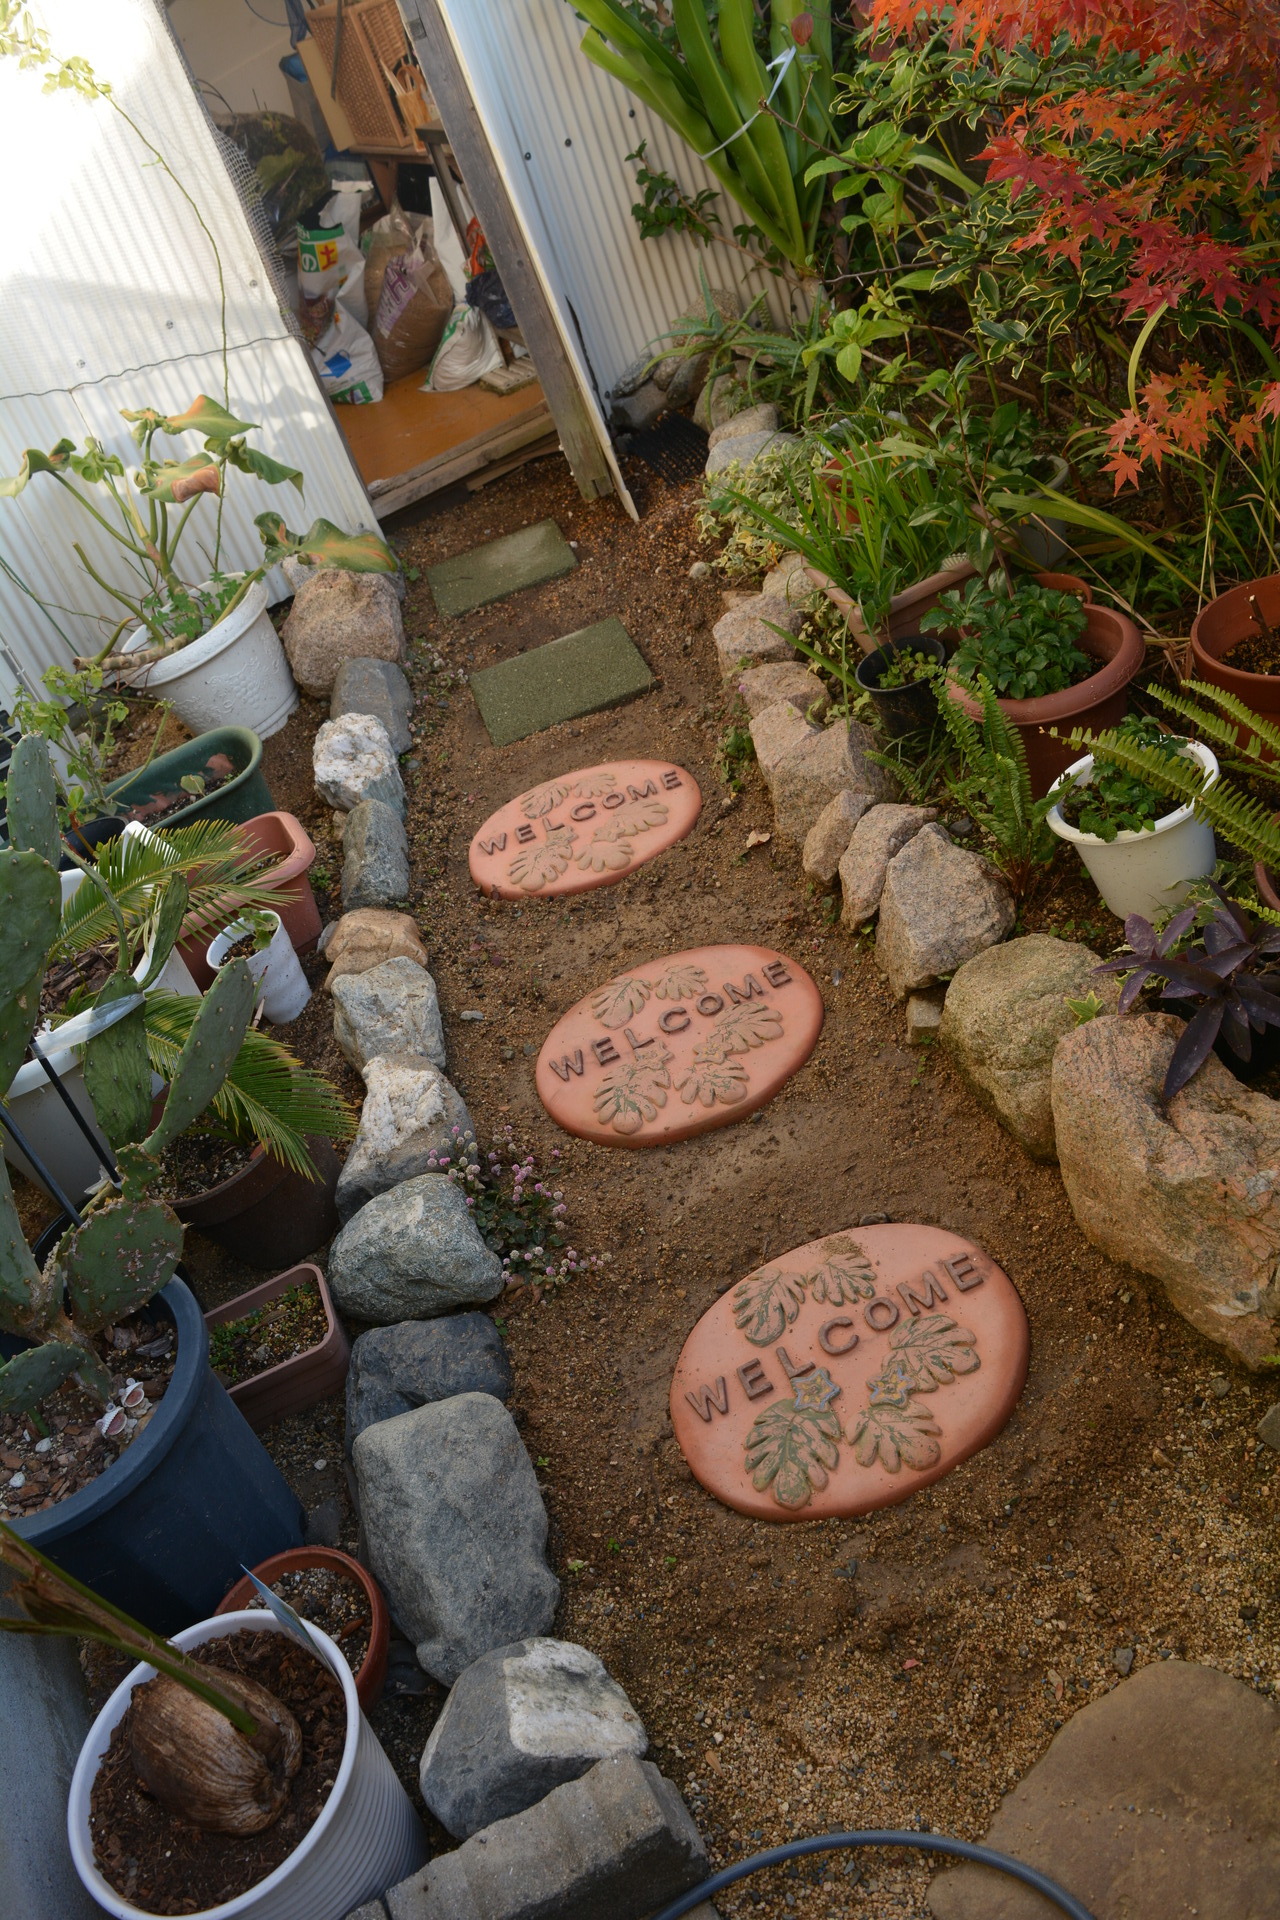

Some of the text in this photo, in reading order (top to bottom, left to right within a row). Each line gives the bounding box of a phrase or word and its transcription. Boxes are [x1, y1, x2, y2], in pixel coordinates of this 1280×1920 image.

[479, 769, 683, 855] WELCOME
[549, 960, 793, 1081] WELCOME
[684, 1252, 984, 1422] WELCOME
